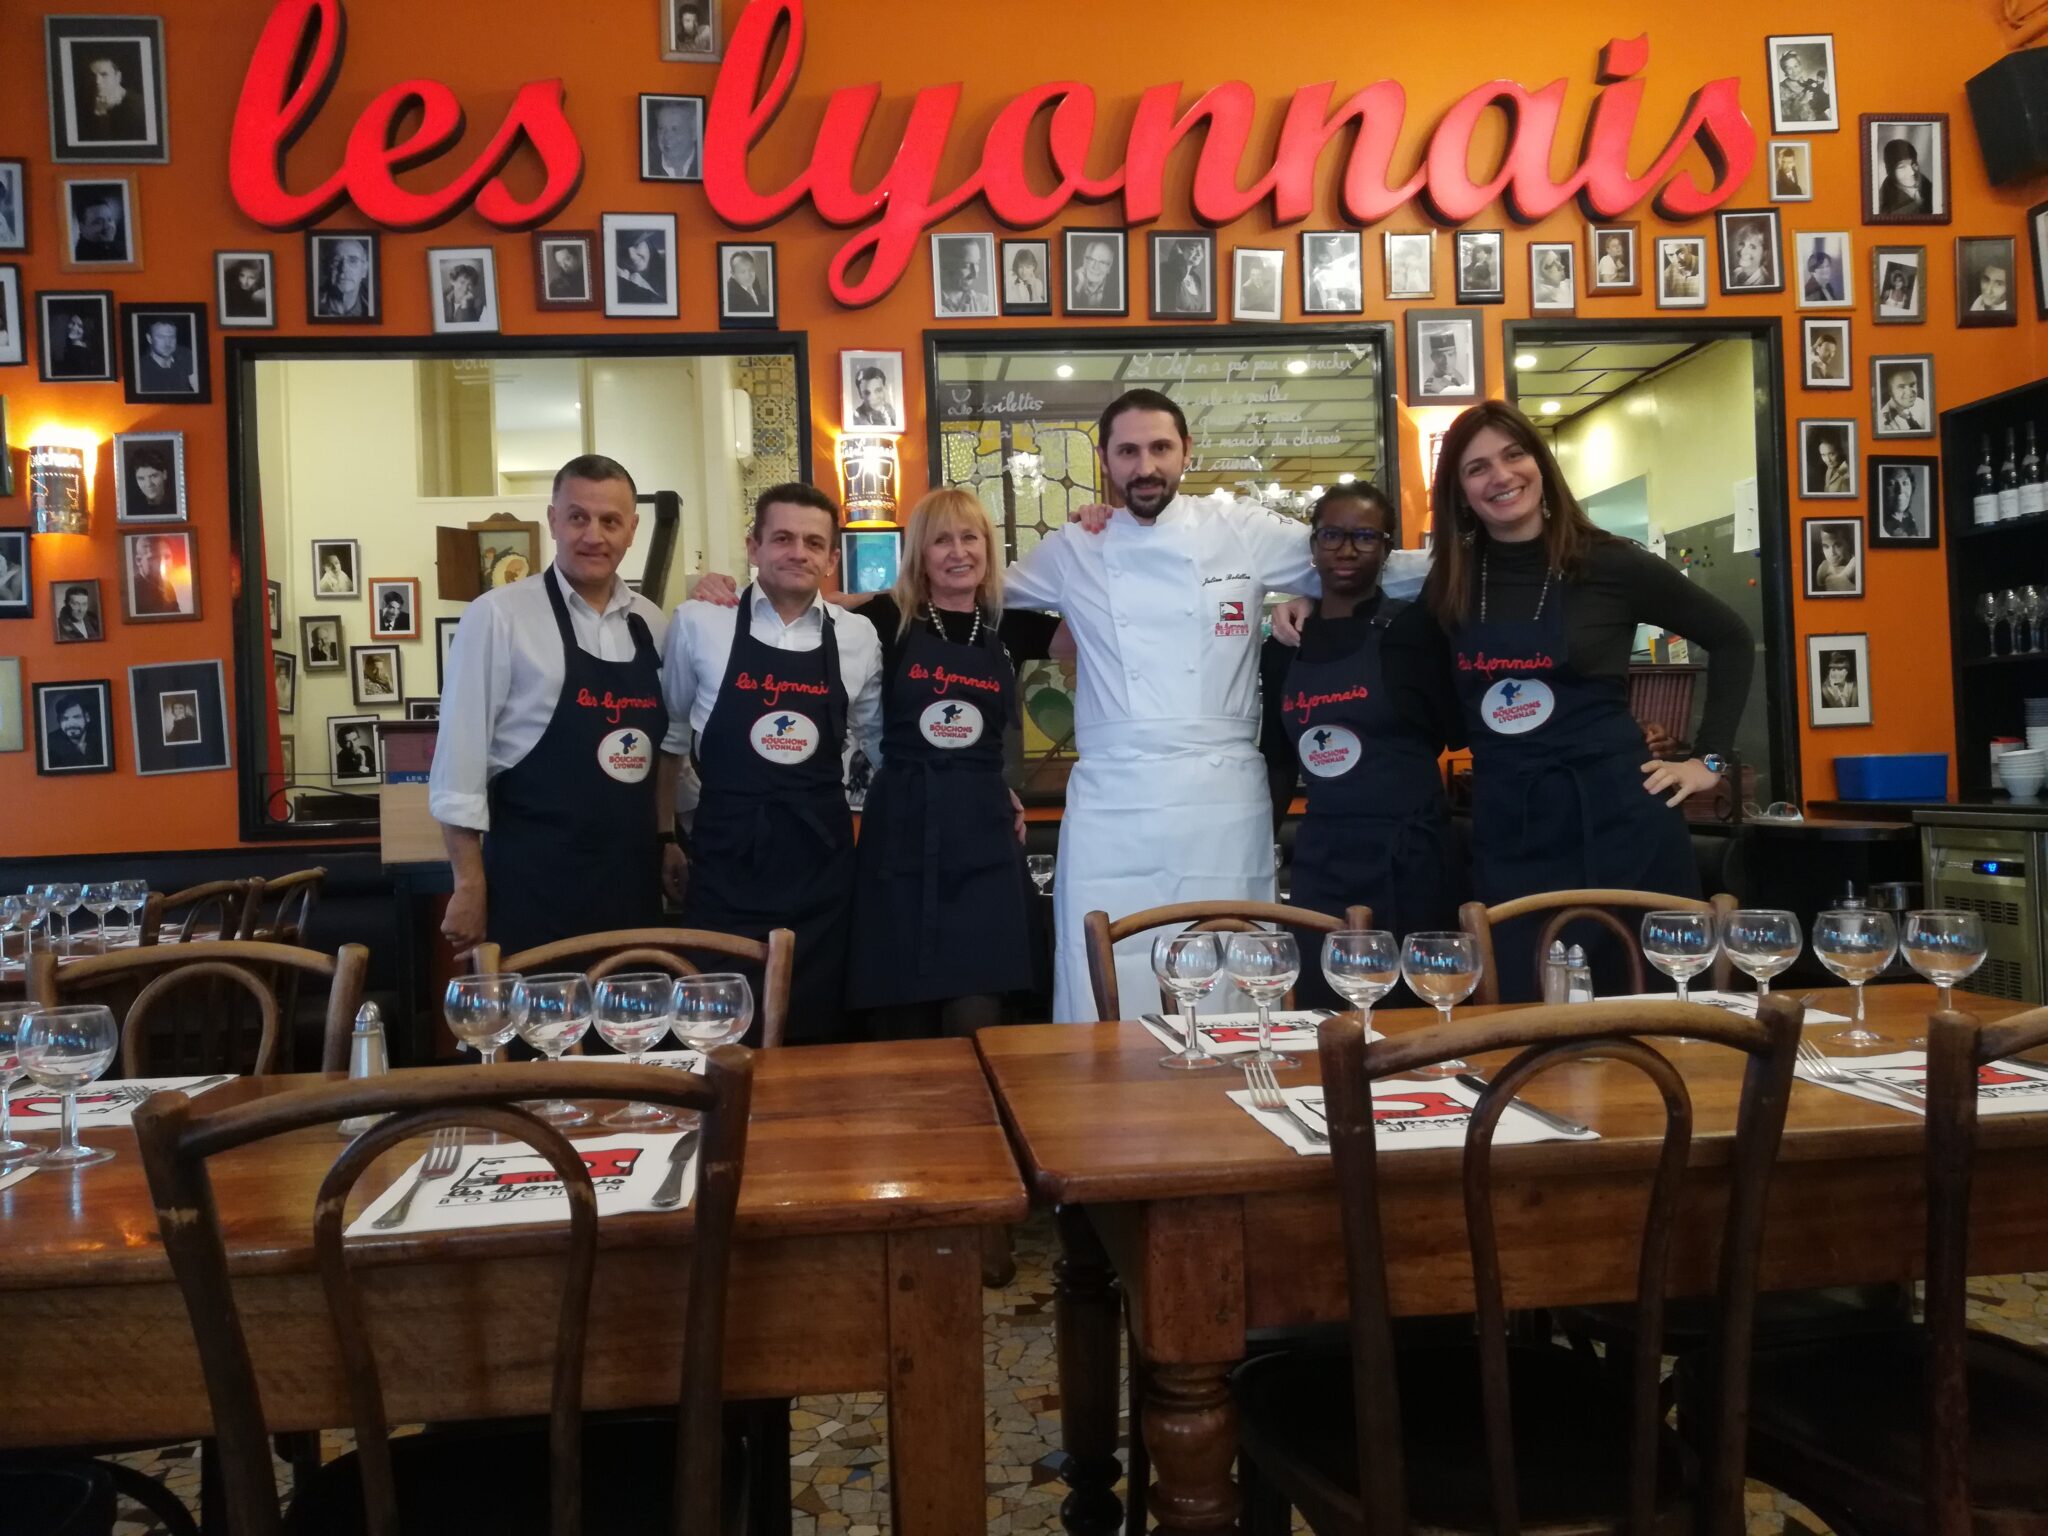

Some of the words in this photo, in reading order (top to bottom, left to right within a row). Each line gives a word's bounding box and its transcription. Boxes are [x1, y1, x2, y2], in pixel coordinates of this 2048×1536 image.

[230, 0, 583, 231] les
[704, 0, 1758, 308] lyonnais
[908, 663, 929, 679] les
[932, 665, 1001, 695] lyonnais
[1473, 651, 1553, 680] lyonnais
[576, 688, 598, 707] les
[736, 672, 758, 689] les
[761, 674, 829, 706] lyonnai
[1296, 685, 1368, 724] lyonnais
[438, 1185, 620, 1205] BOUCHN
